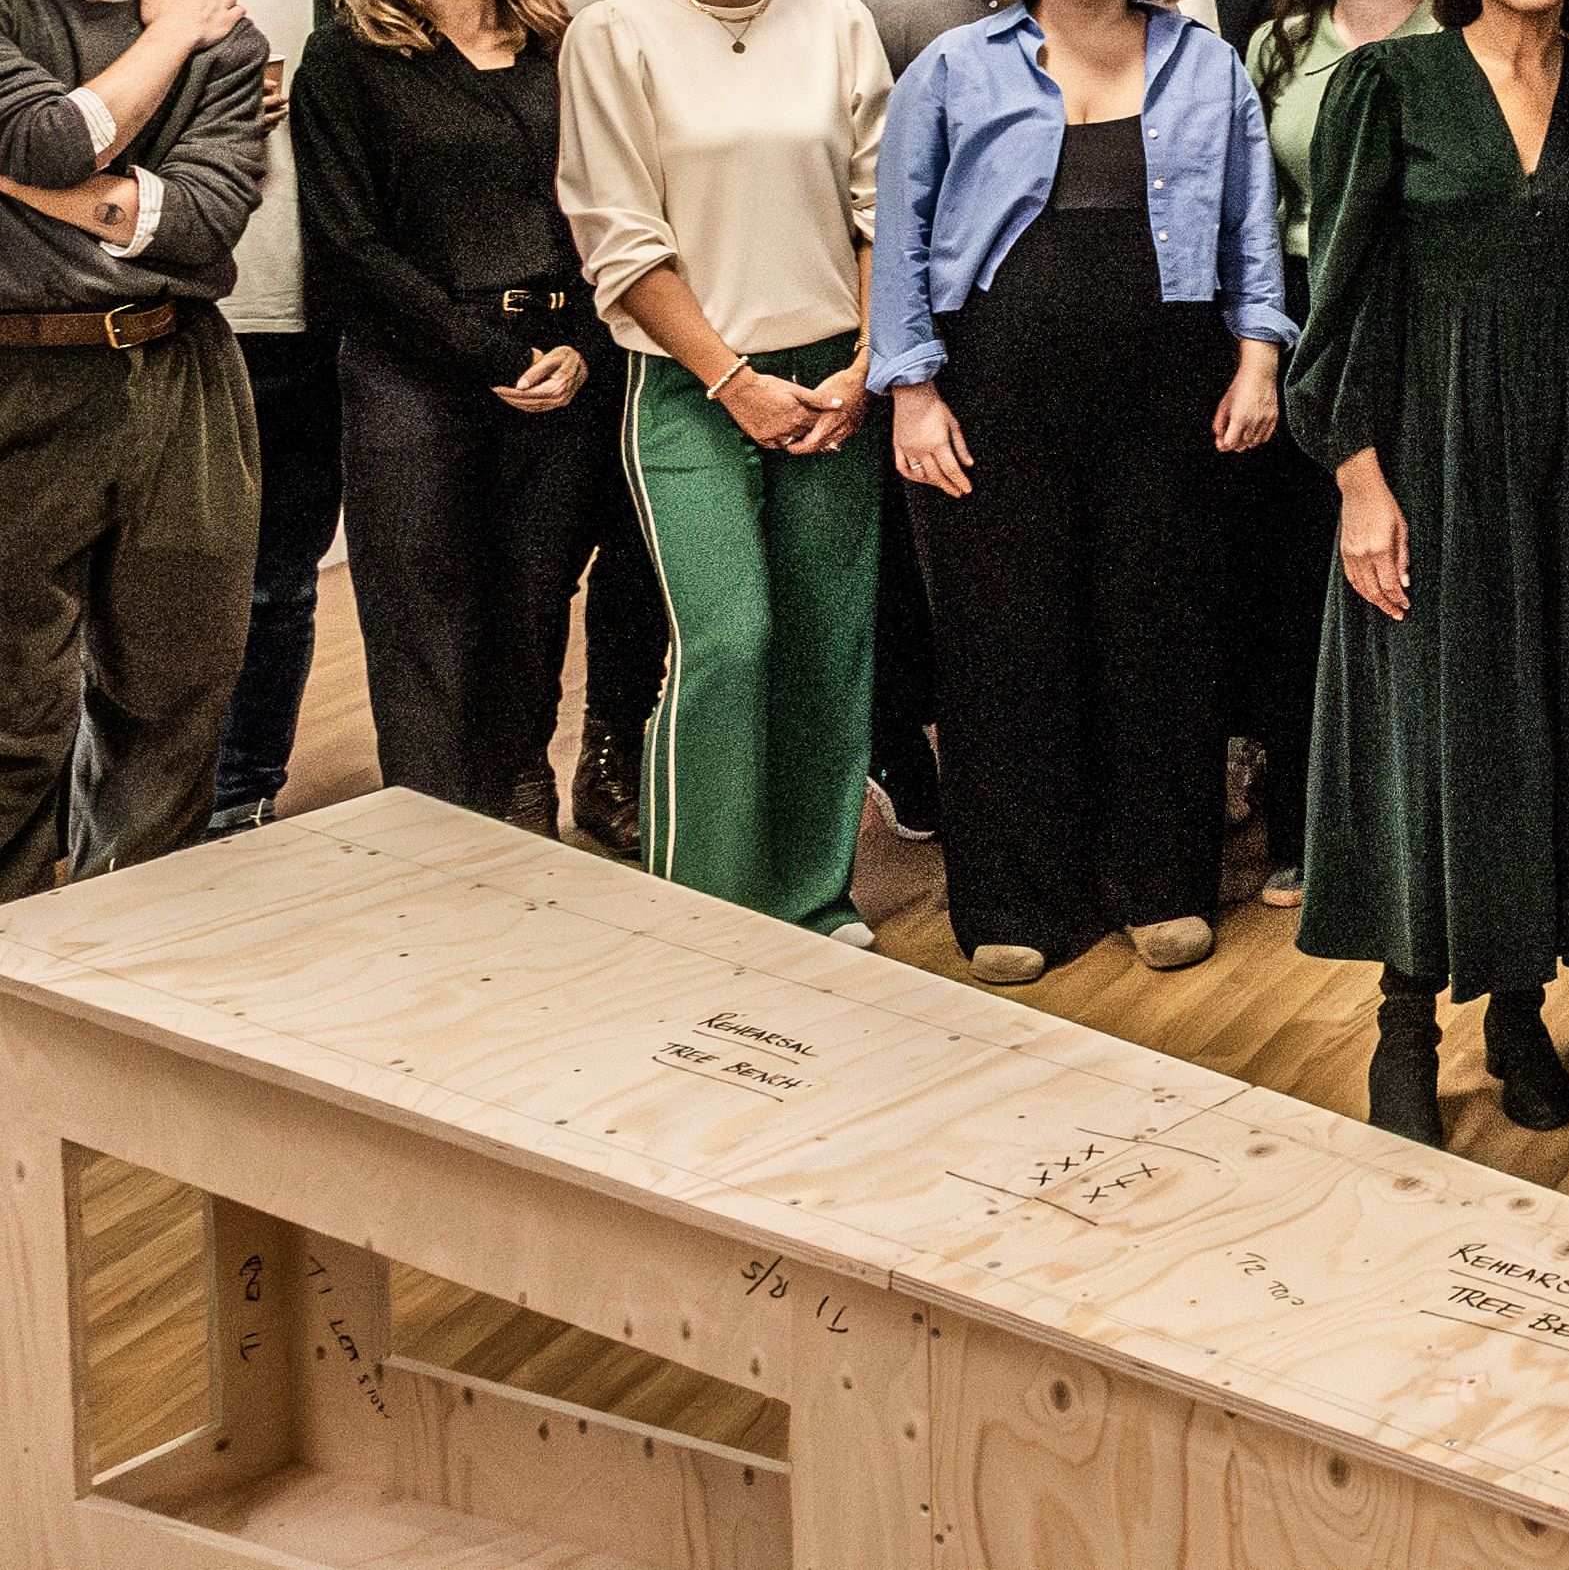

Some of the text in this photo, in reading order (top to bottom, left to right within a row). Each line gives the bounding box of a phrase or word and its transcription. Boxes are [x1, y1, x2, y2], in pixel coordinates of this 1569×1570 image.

[697, 1012, 820, 1058] REHEARSAL
[659, 1042, 720, 1064] TREE
[1447, 1285, 1527, 1319] TREE
